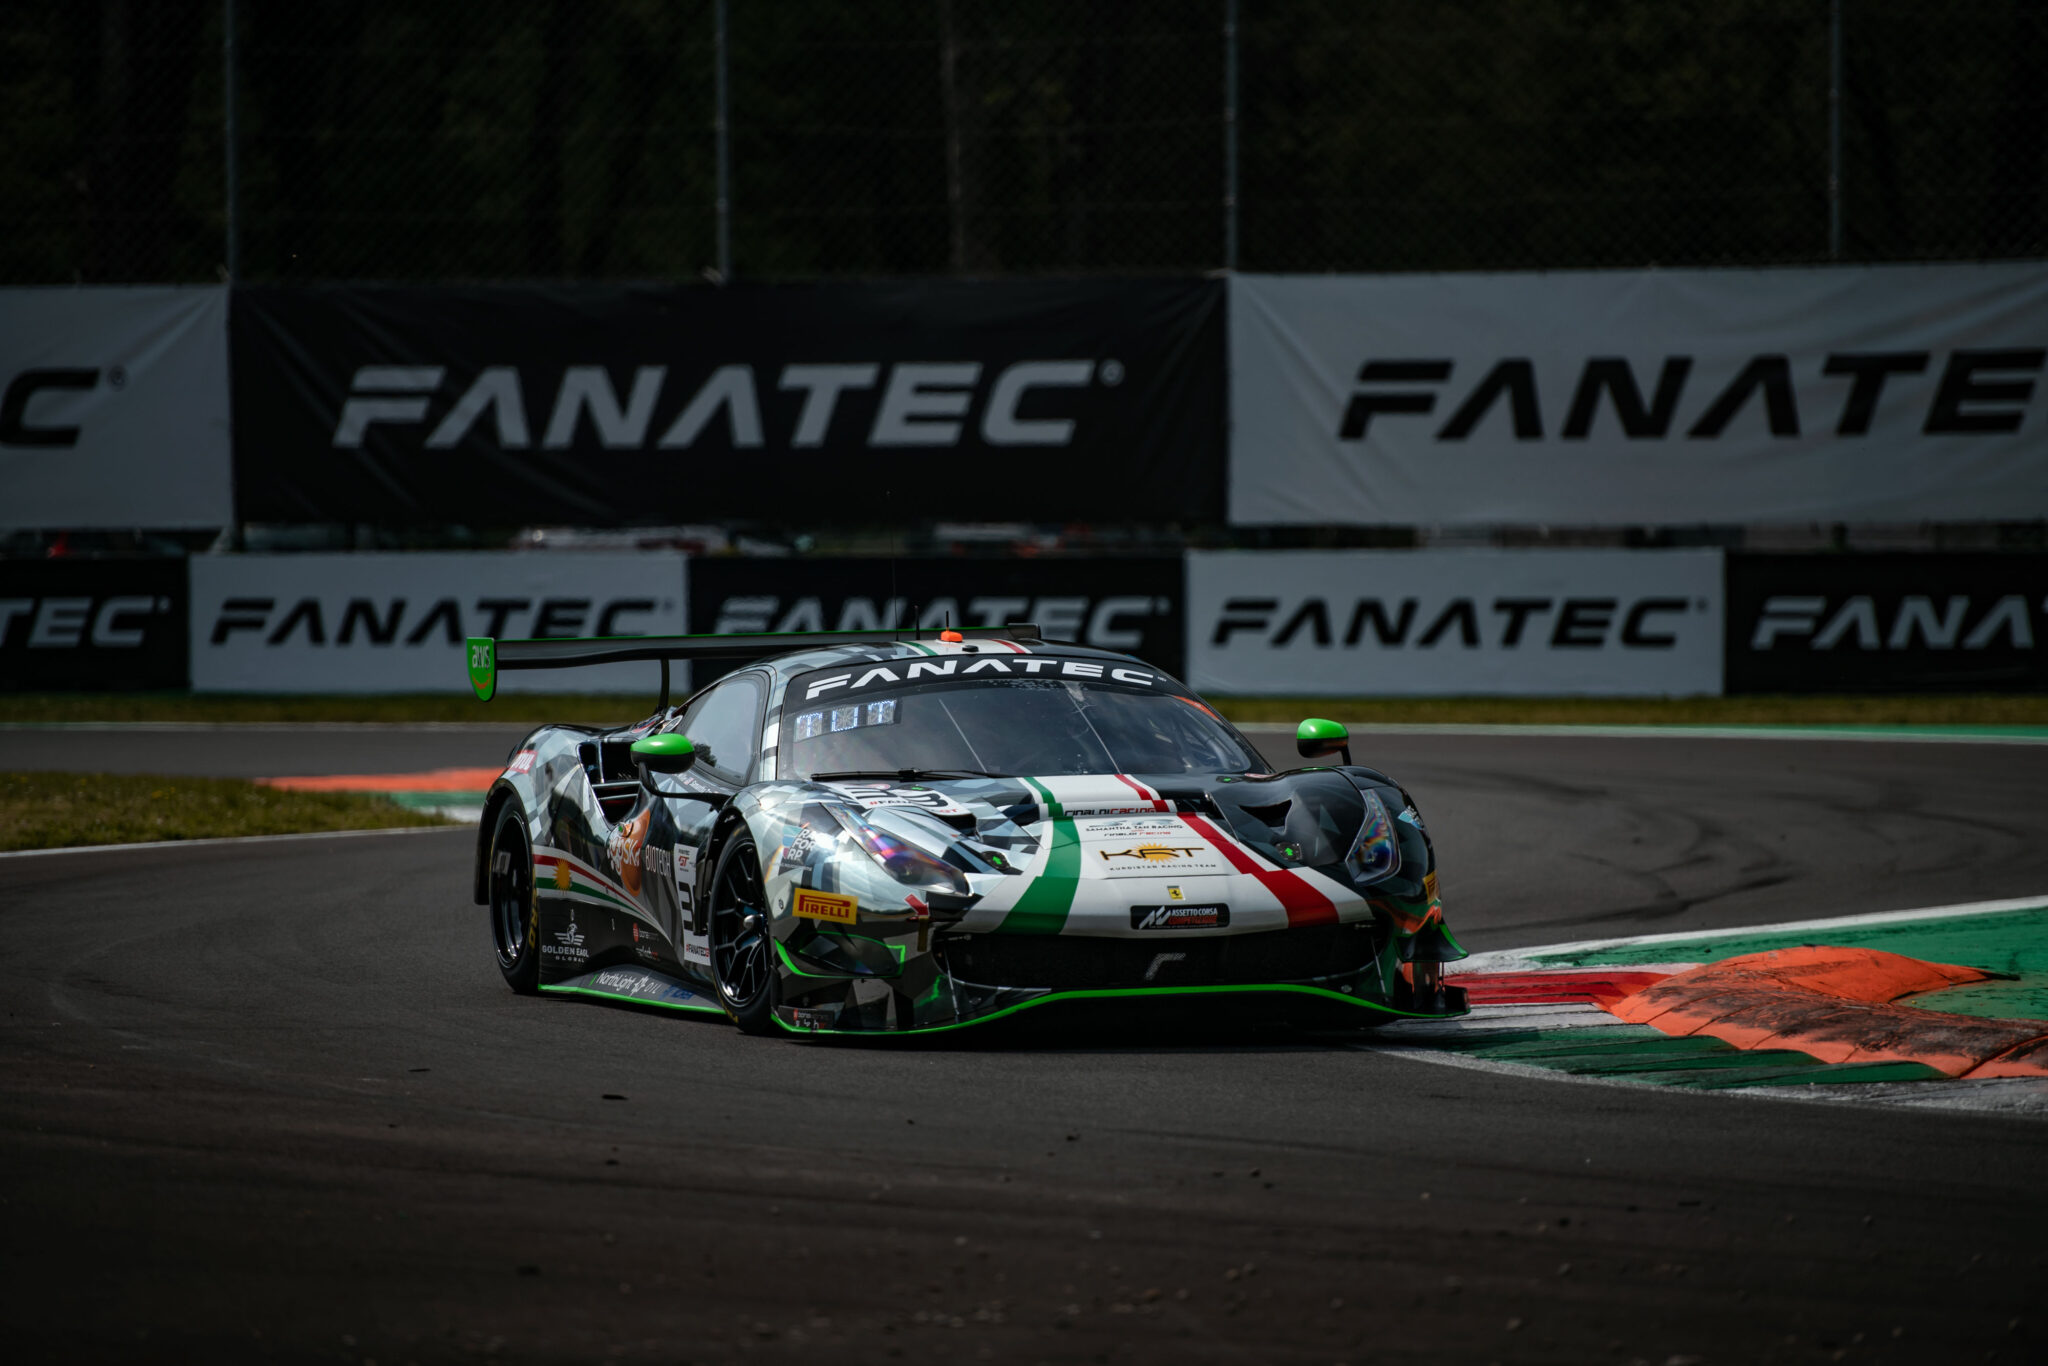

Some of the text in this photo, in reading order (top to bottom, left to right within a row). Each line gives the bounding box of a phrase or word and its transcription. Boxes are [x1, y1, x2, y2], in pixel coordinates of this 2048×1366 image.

[332, 360, 1094, 450] FANATEC
[1338, 350, 2046, 440] FANATE
[210, 598, 656, 647] FANATEC
[714, 595, 1159, 648] FANATEC
[1213, 598, 1690, 649] FANATEC
[1750, 594, 2048, 650] FANA
[806, 658, 1154, 700] FANATEC
[798, 894, 851, 918] PIRELLI
[1171, 907, 1218, 916] ASSETTO CORSA
[542, 944, 575, 955] GOLDEN
